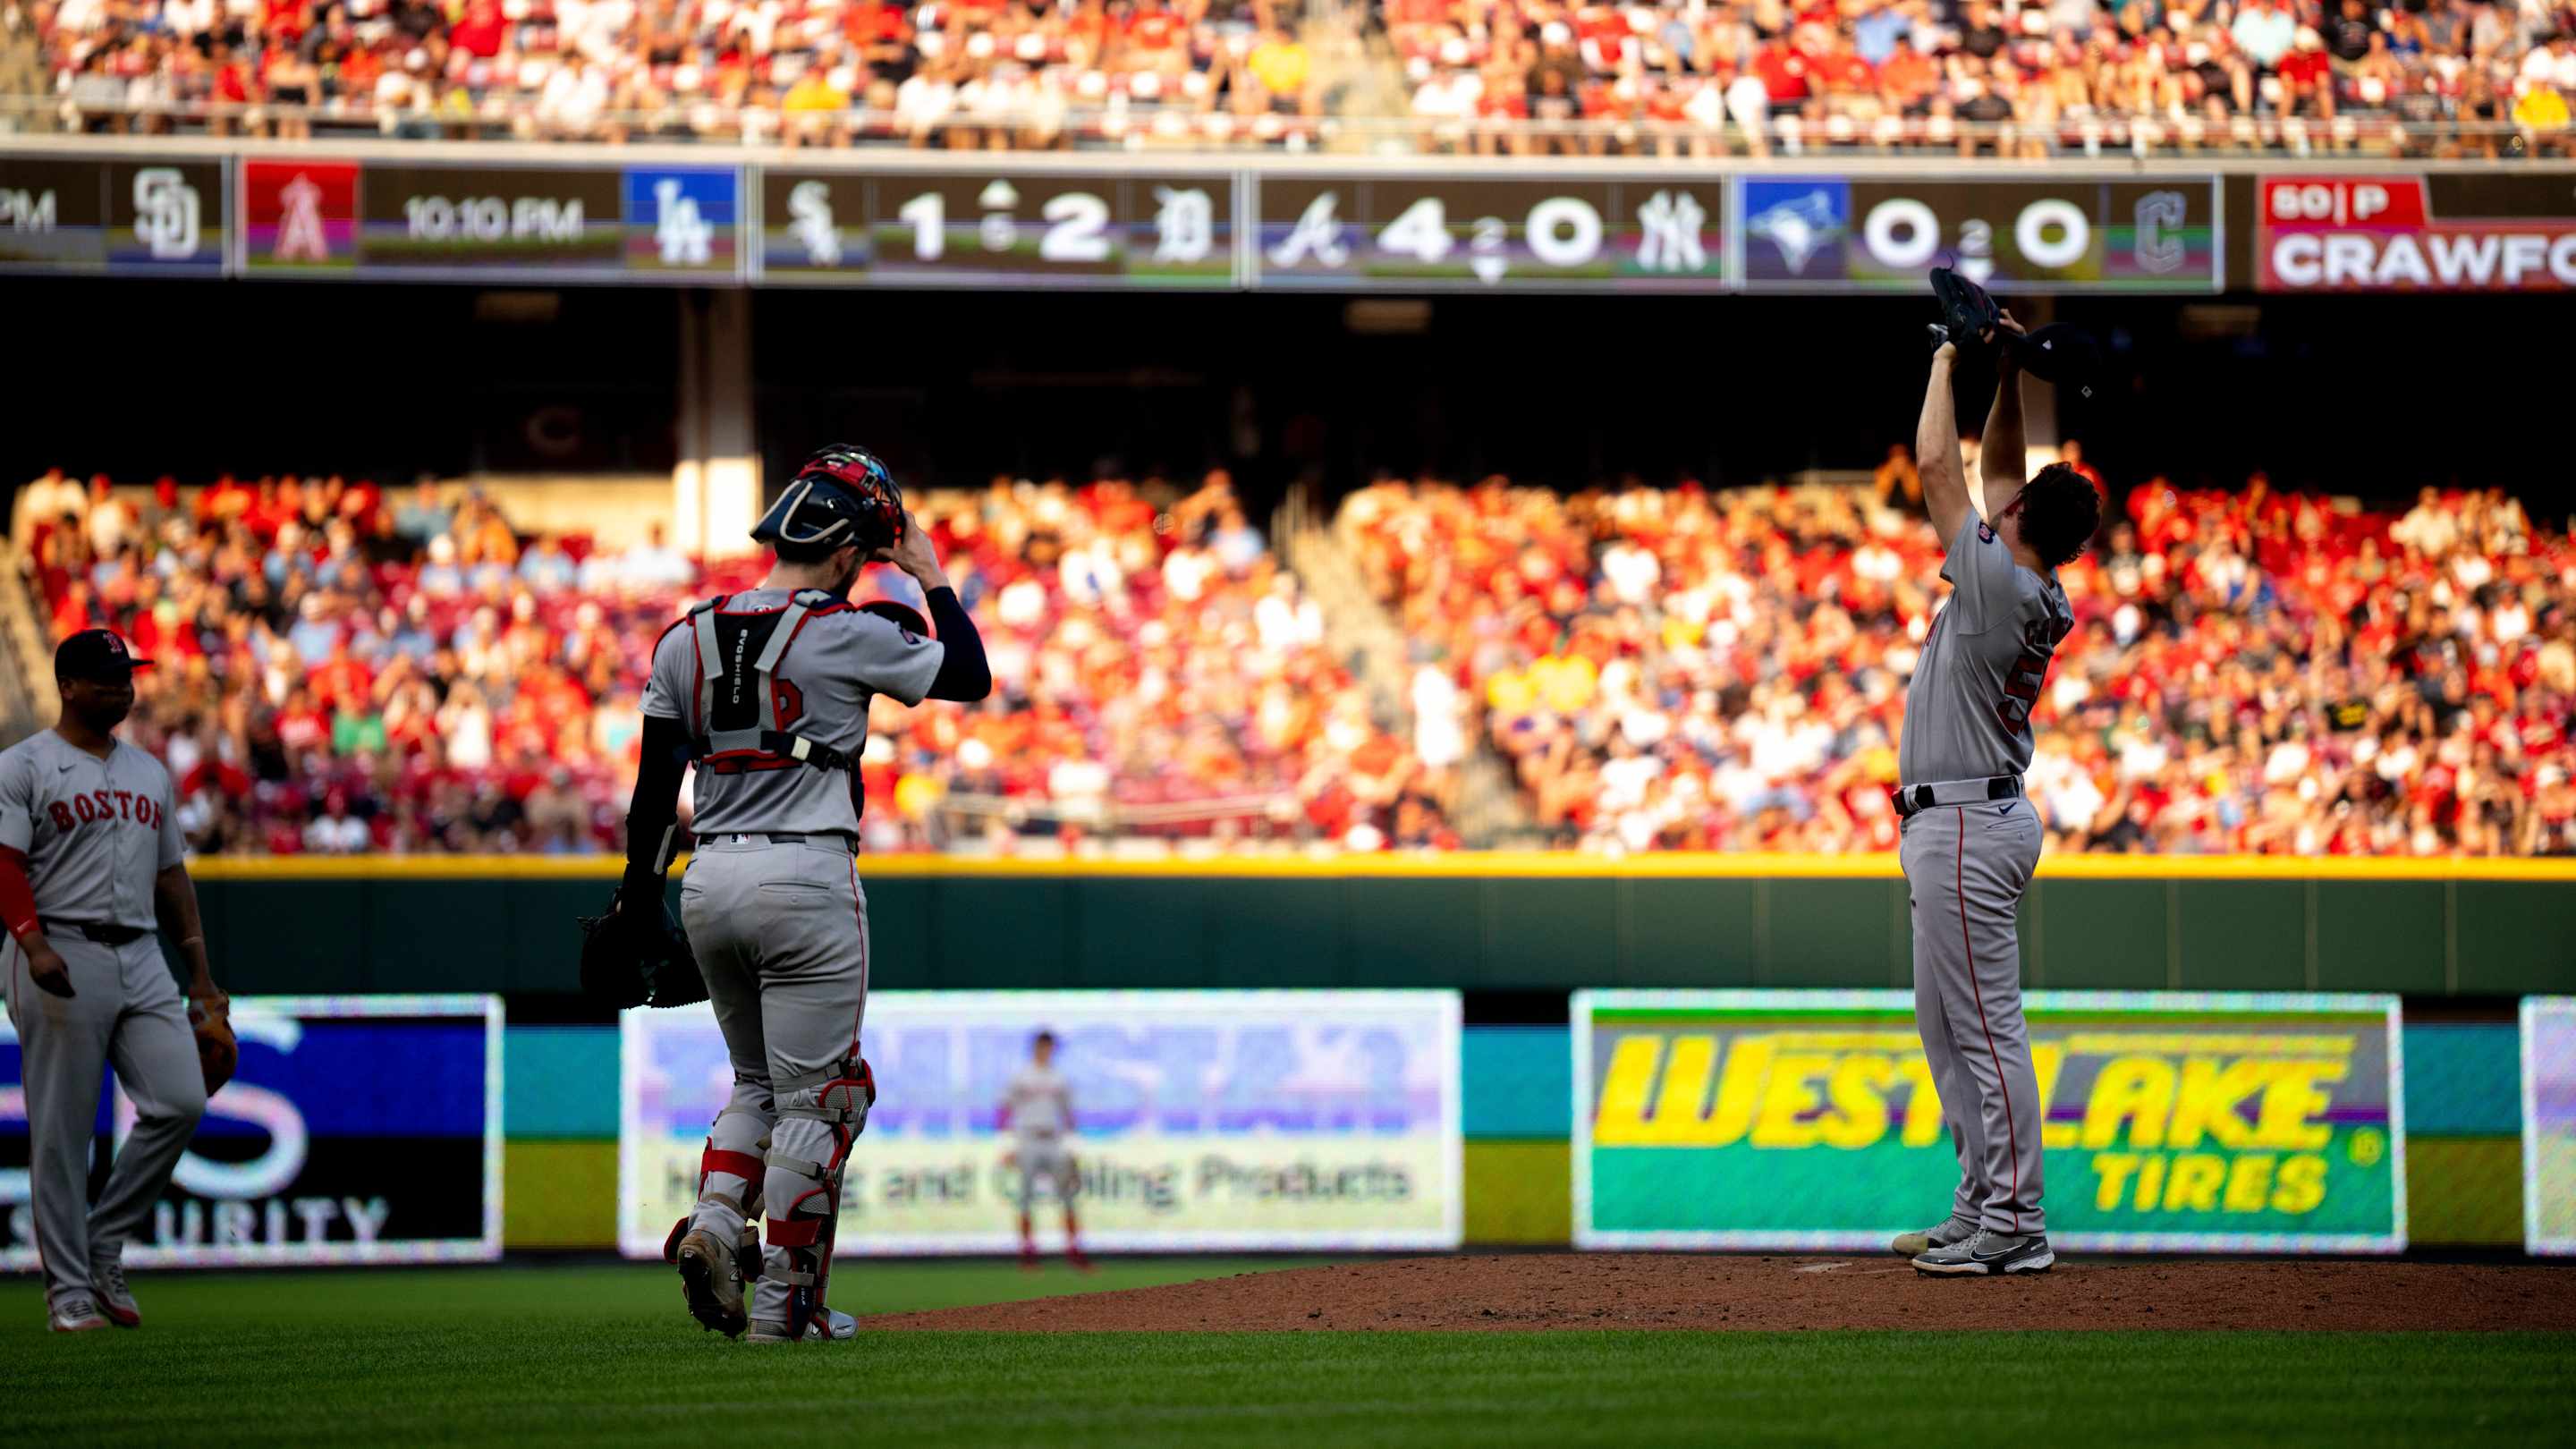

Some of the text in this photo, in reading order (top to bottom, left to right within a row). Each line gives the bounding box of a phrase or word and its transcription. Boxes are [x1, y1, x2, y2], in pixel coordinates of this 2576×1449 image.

[404, 195, 585, 243] 10:10 PM
[898, 190, 945, 261] 1
[1039, 191, 1112, 261] 2
[1377, 196, 1456, 264] 4
[1524, 196, 1604, 267] 0
[1862, 198, 1941, 268] 0
[2014, 198, 2091, 268] 0
[47, 789, 163, 835] BOSTON
[2092, 1155, 2327, 1215] TIRES
[9, 1196, 390, 1243] SURITY
